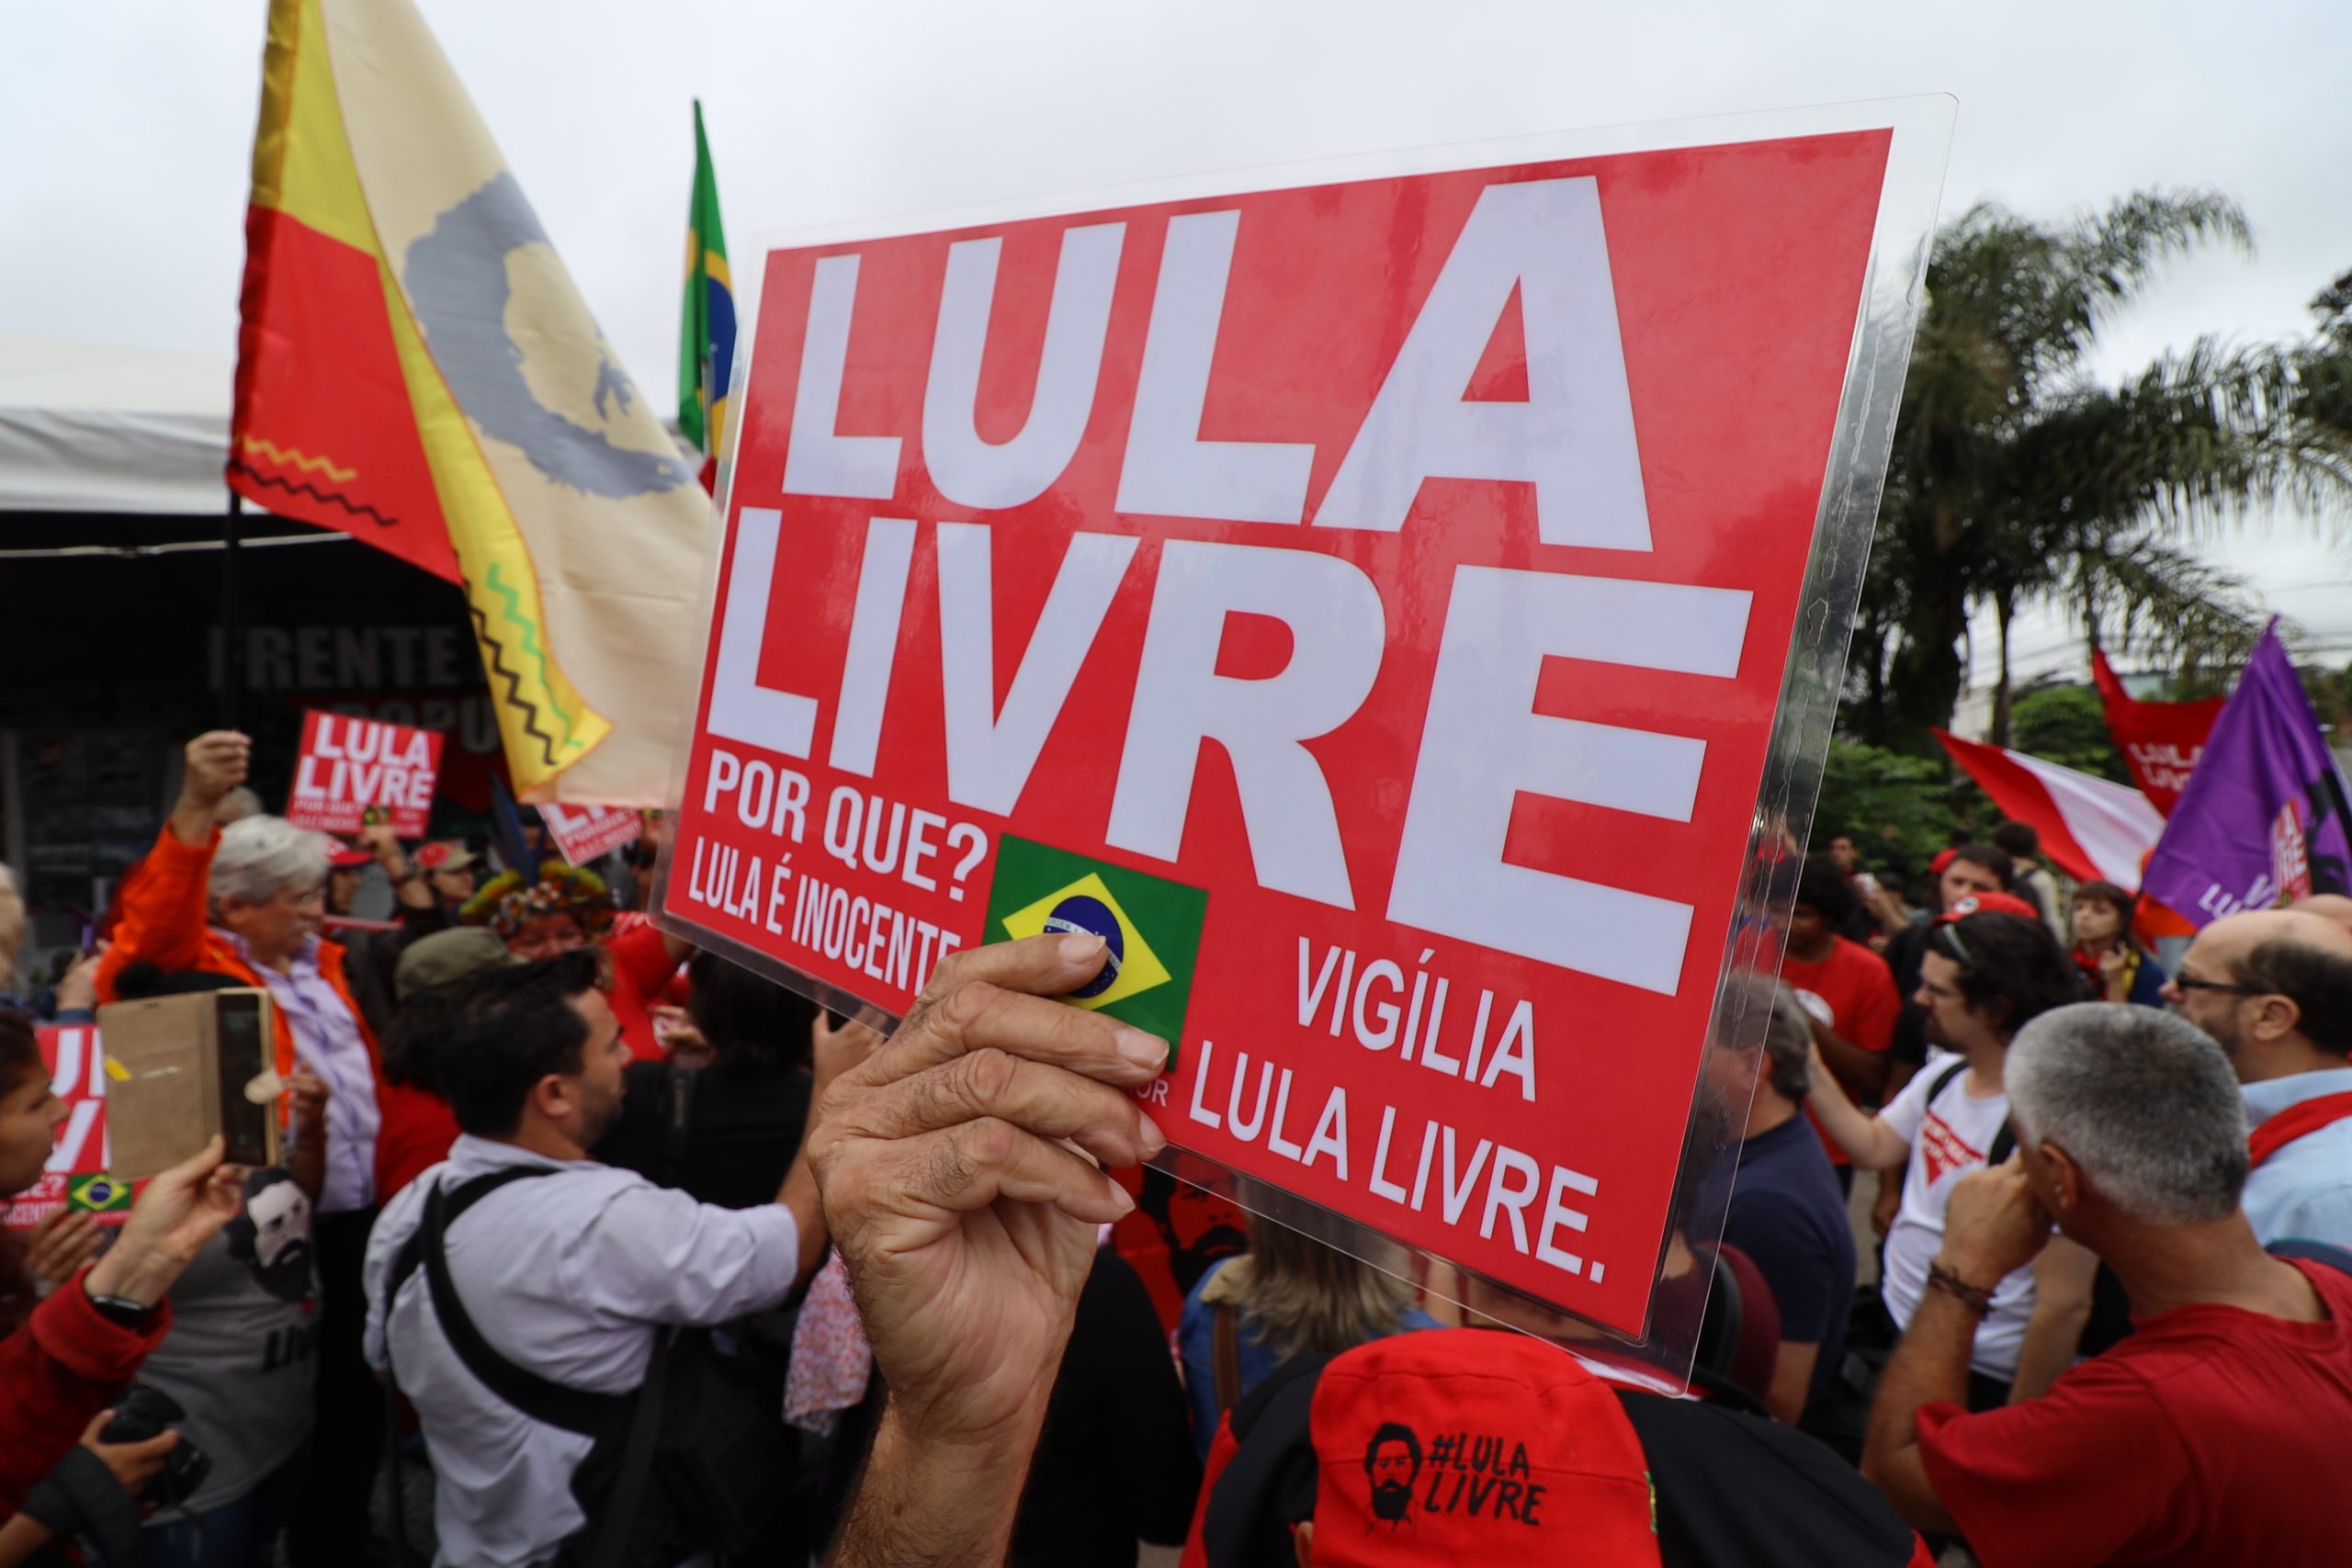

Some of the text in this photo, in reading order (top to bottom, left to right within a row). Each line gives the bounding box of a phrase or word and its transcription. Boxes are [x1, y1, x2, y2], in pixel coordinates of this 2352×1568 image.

[782, 175, 1653, 551] LULA
[295, 755, 435, 808] LIVRE
[313, 714, 430, 769] LULA
[707, 506, 1753, 996] LIVRE
[688, 836, 762, 925] LULA
[765, 852, 792, 935] É
[704, 749, 988, 902] POR QUE?
[1298, 936, 1535, 1102] VIGÍLIA
[1189, 1040, 1605, 1285] LULA LIVRE.
[1425, 1472, 1546, 1526] LIVRE
[1429, 1433, 1529, 1480] #LULA
